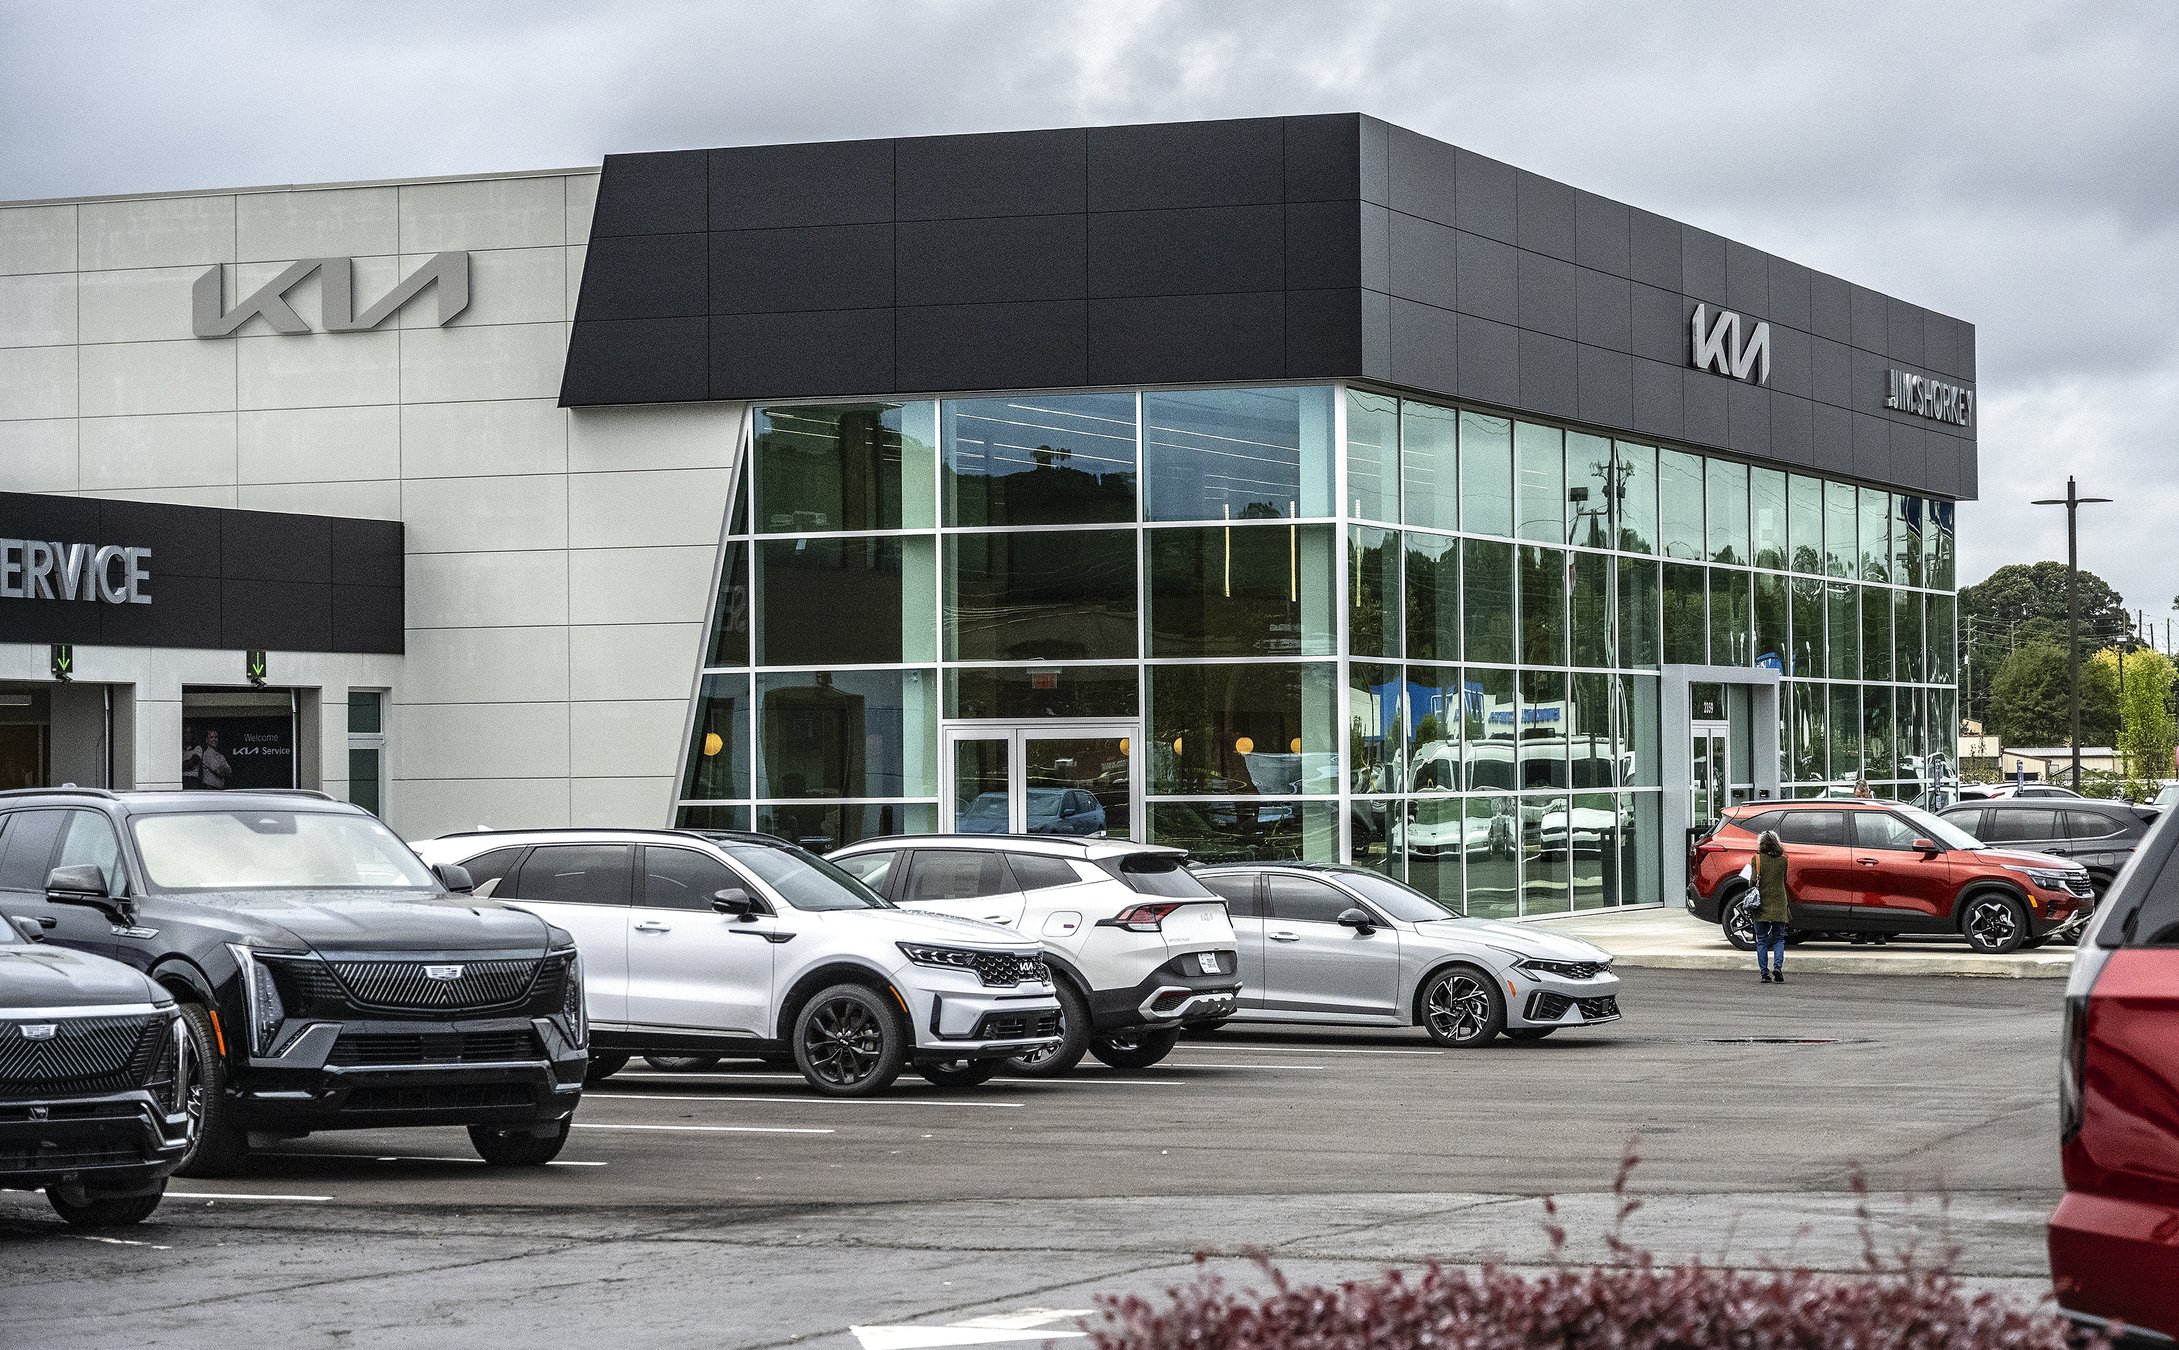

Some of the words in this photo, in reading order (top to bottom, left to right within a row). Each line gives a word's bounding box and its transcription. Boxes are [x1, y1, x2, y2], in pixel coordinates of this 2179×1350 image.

[192, 251, 470, 338] KIA
[1692, 303, 1770, 385] KIA
[1888, 369, 1914, 412] JIM
[1914, 375, 1973, 427] SHORKEY
[232, 746, 260, 756] KIA
[262, 746, 291, 756] Service
[244, 733, 279, 742] Welcome
